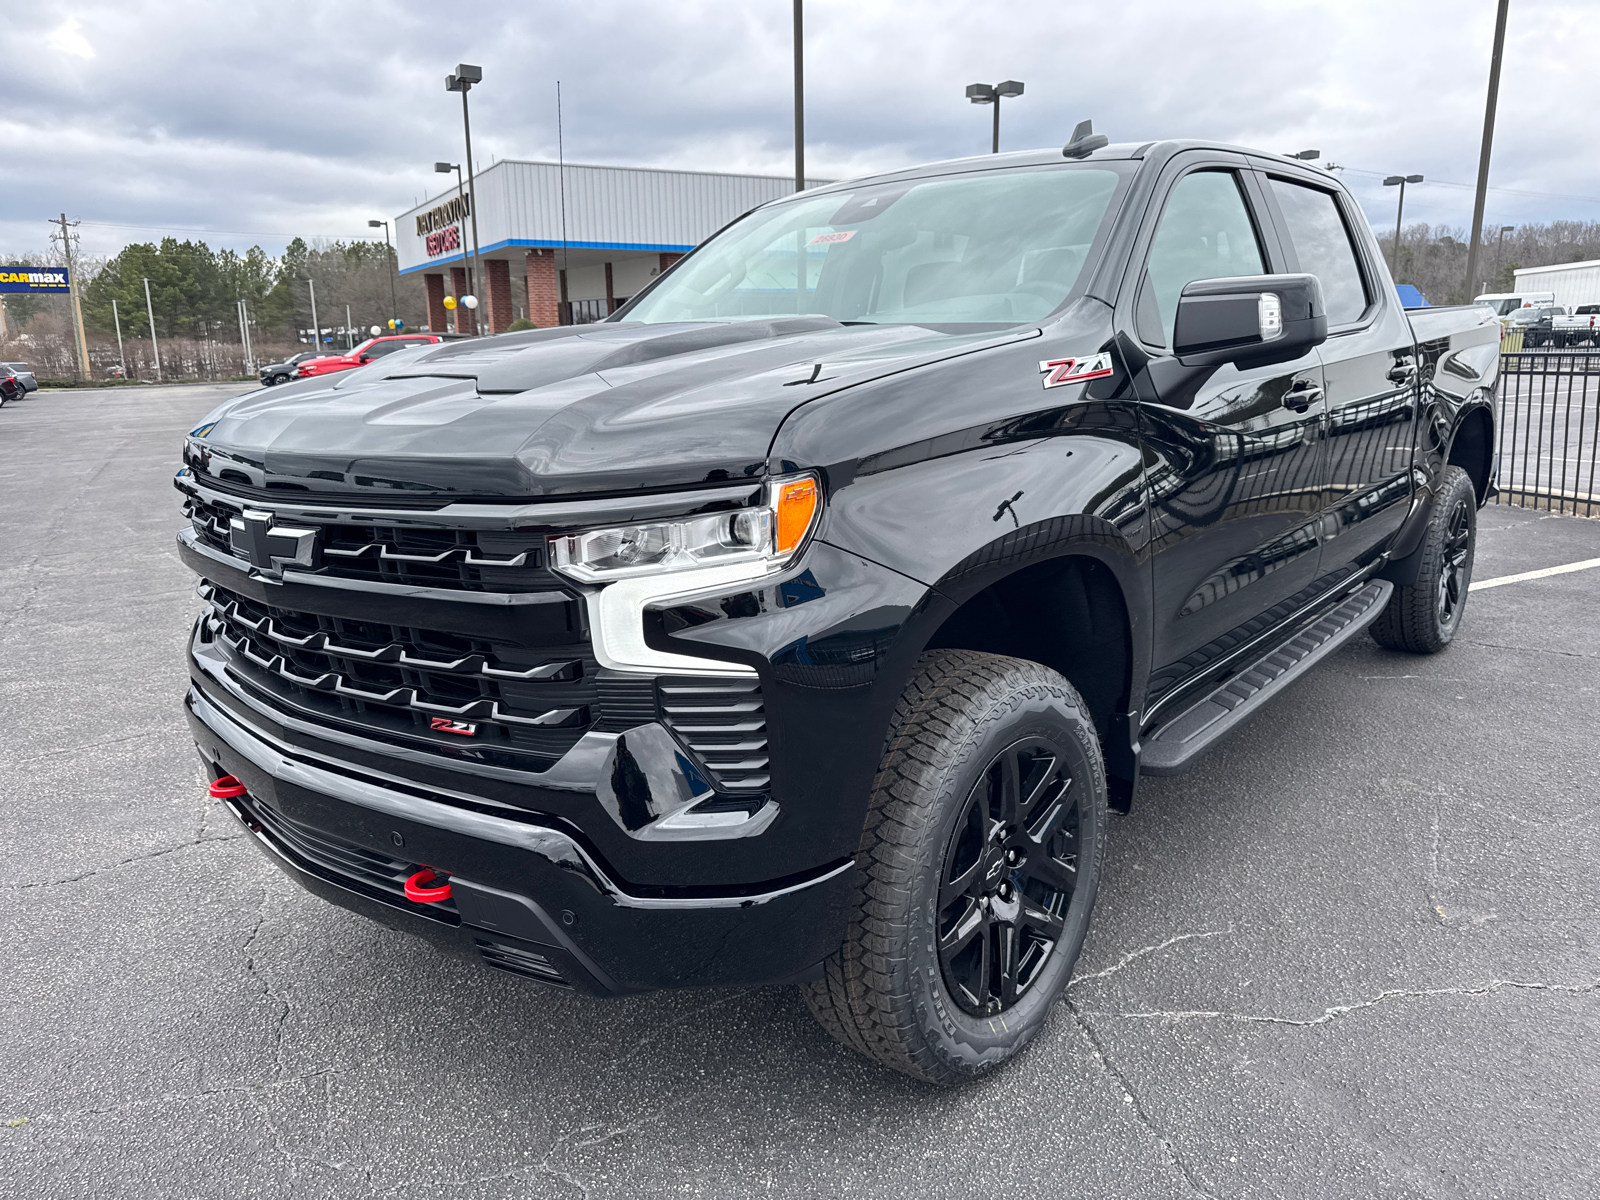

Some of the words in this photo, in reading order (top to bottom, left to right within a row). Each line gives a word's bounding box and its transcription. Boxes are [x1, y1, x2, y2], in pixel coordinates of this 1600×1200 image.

[440, 226, 460, 251] CARS
[1038, 351, 1114, 390] Z71
[430, 717, 477, 736] Z71
